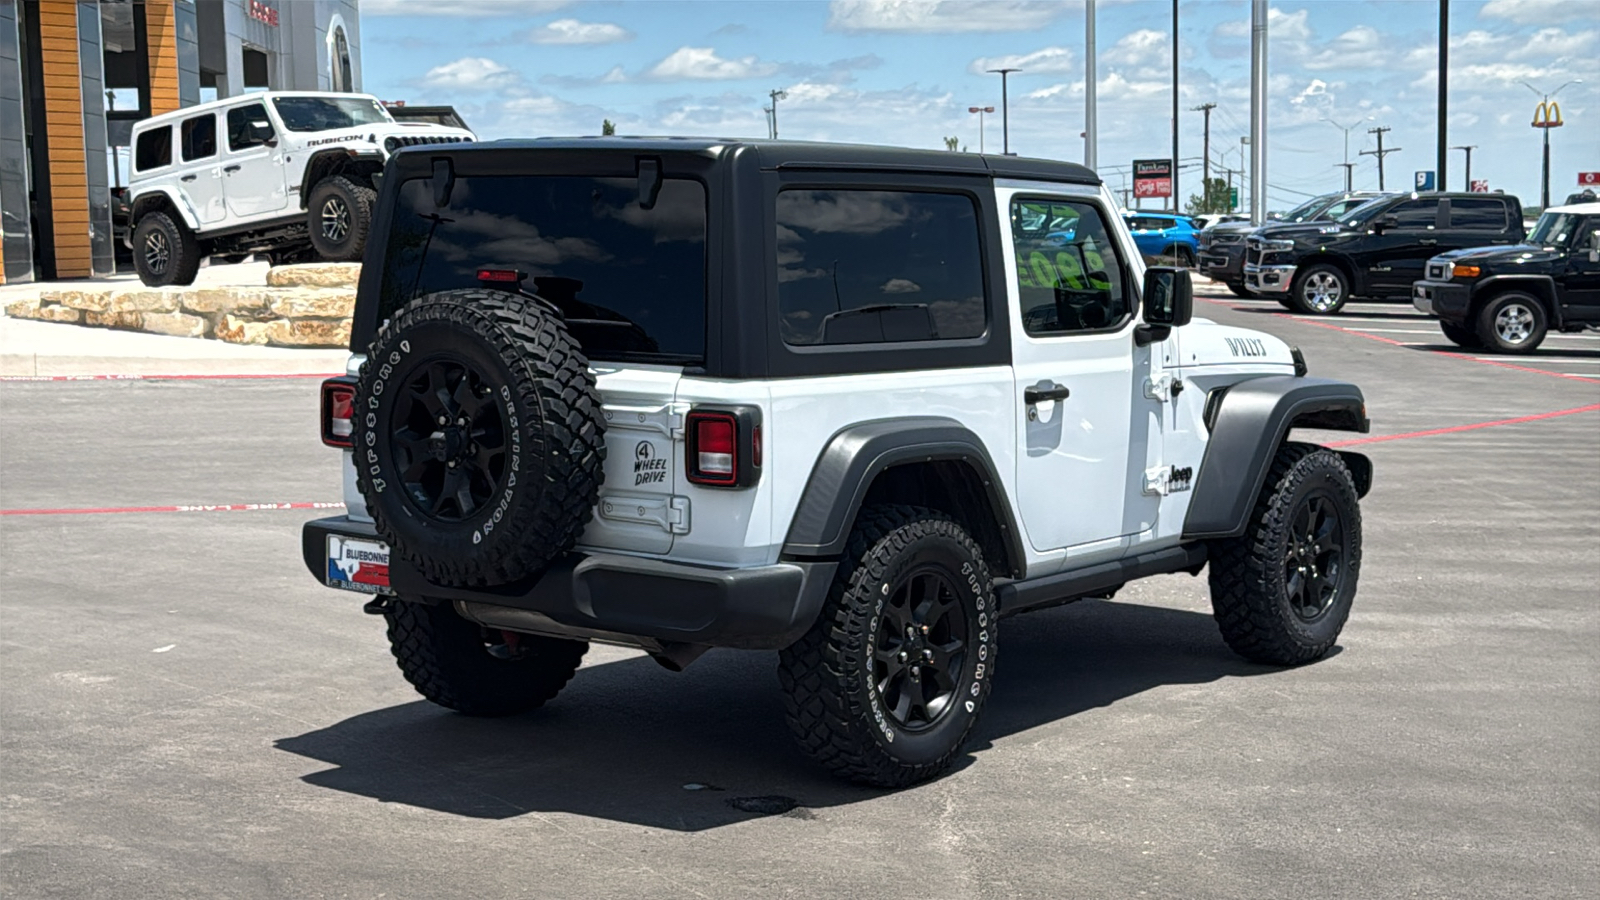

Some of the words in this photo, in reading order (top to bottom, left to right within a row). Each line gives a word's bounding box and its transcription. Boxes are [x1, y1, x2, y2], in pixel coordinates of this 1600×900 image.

[307, 134, 364, 148] RUBICON
[1224, 337, 1267, 357] WILLYS
[483, 385, 520, 535] DESTINATION
[634, 458, 667, 473] WHEEL
[635, 471, 667, 486] DRIVE
[1168, 464, 1193, 483] Jeep
[866, 599, 895, 742] DESTINATION
